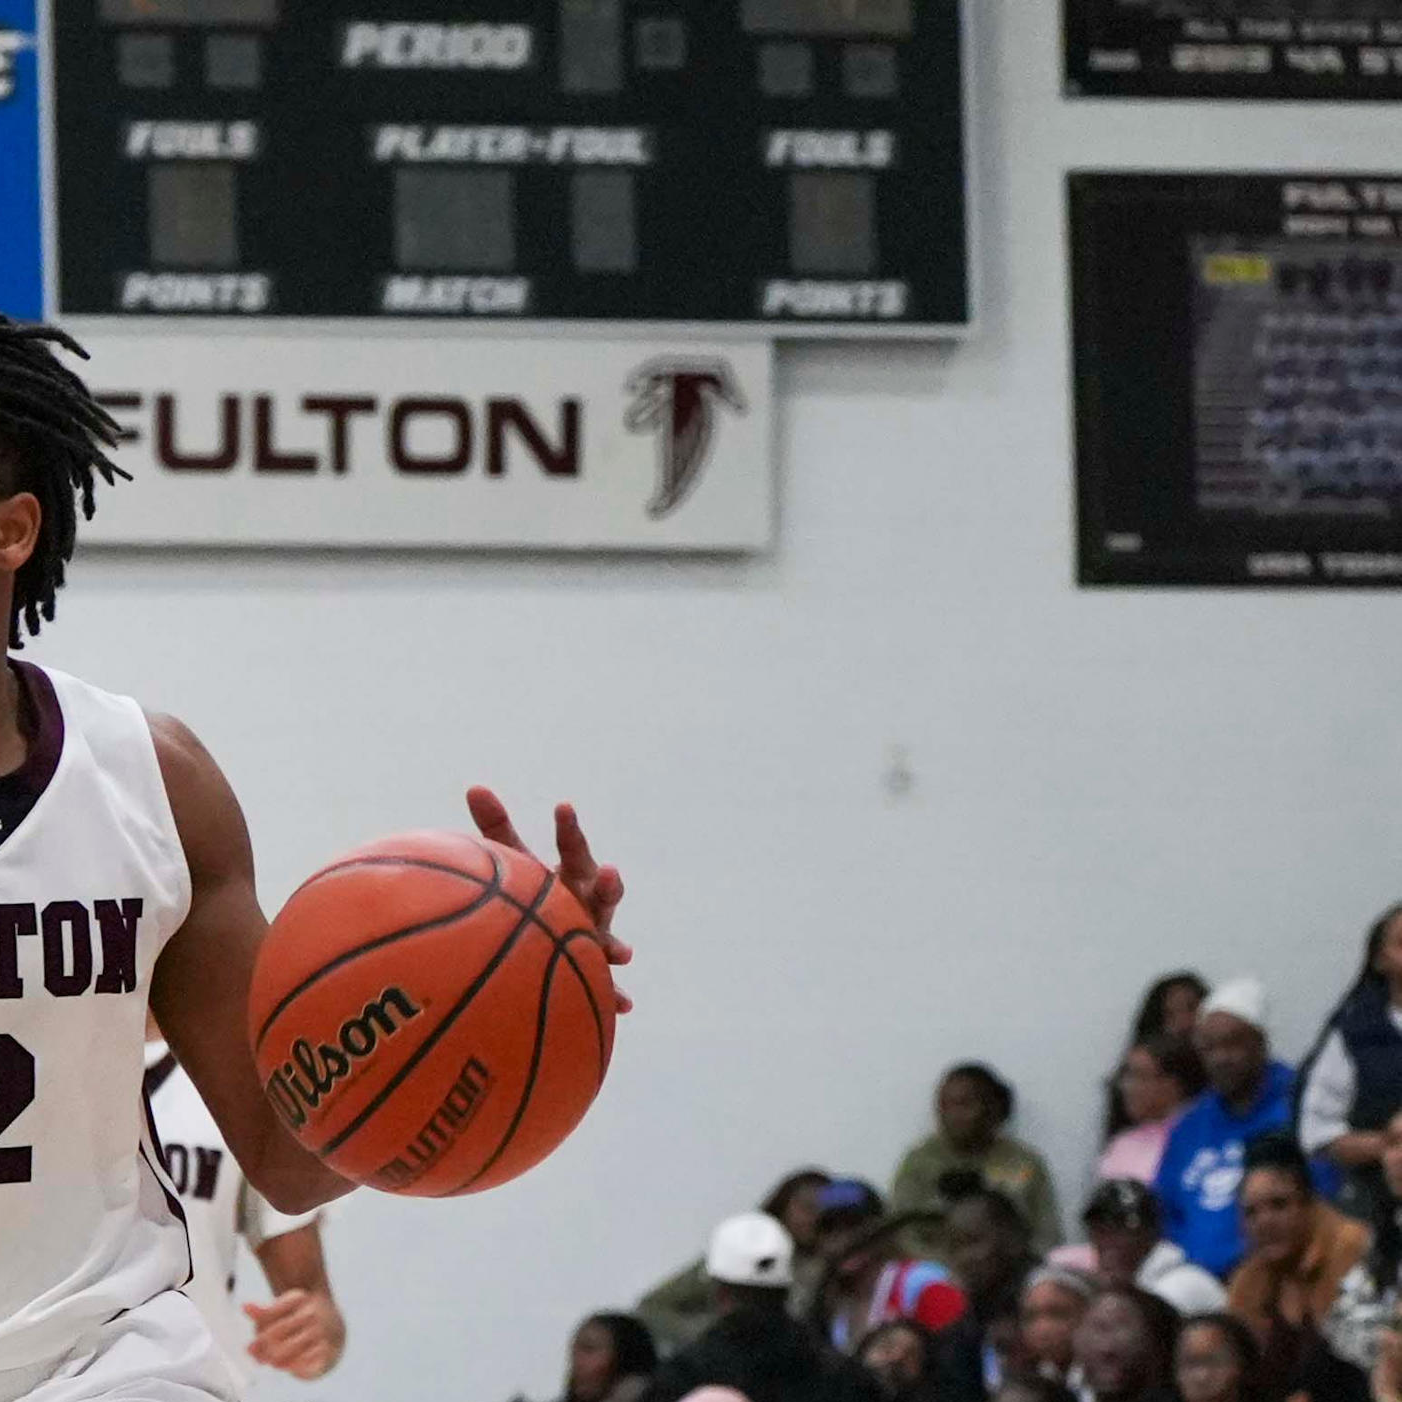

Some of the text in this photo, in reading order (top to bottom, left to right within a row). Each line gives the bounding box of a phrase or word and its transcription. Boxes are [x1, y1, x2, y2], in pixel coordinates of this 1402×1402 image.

[343, 22, 531, 69] PERIOD
[126, 120, 256, 158] FOULS
[766, 130, 892, 166] FOULS
[121, 272, 269, 311] POINTS
[382, 276, 528, 312] MATCH
[763, 280, 905, 316] POINTS
